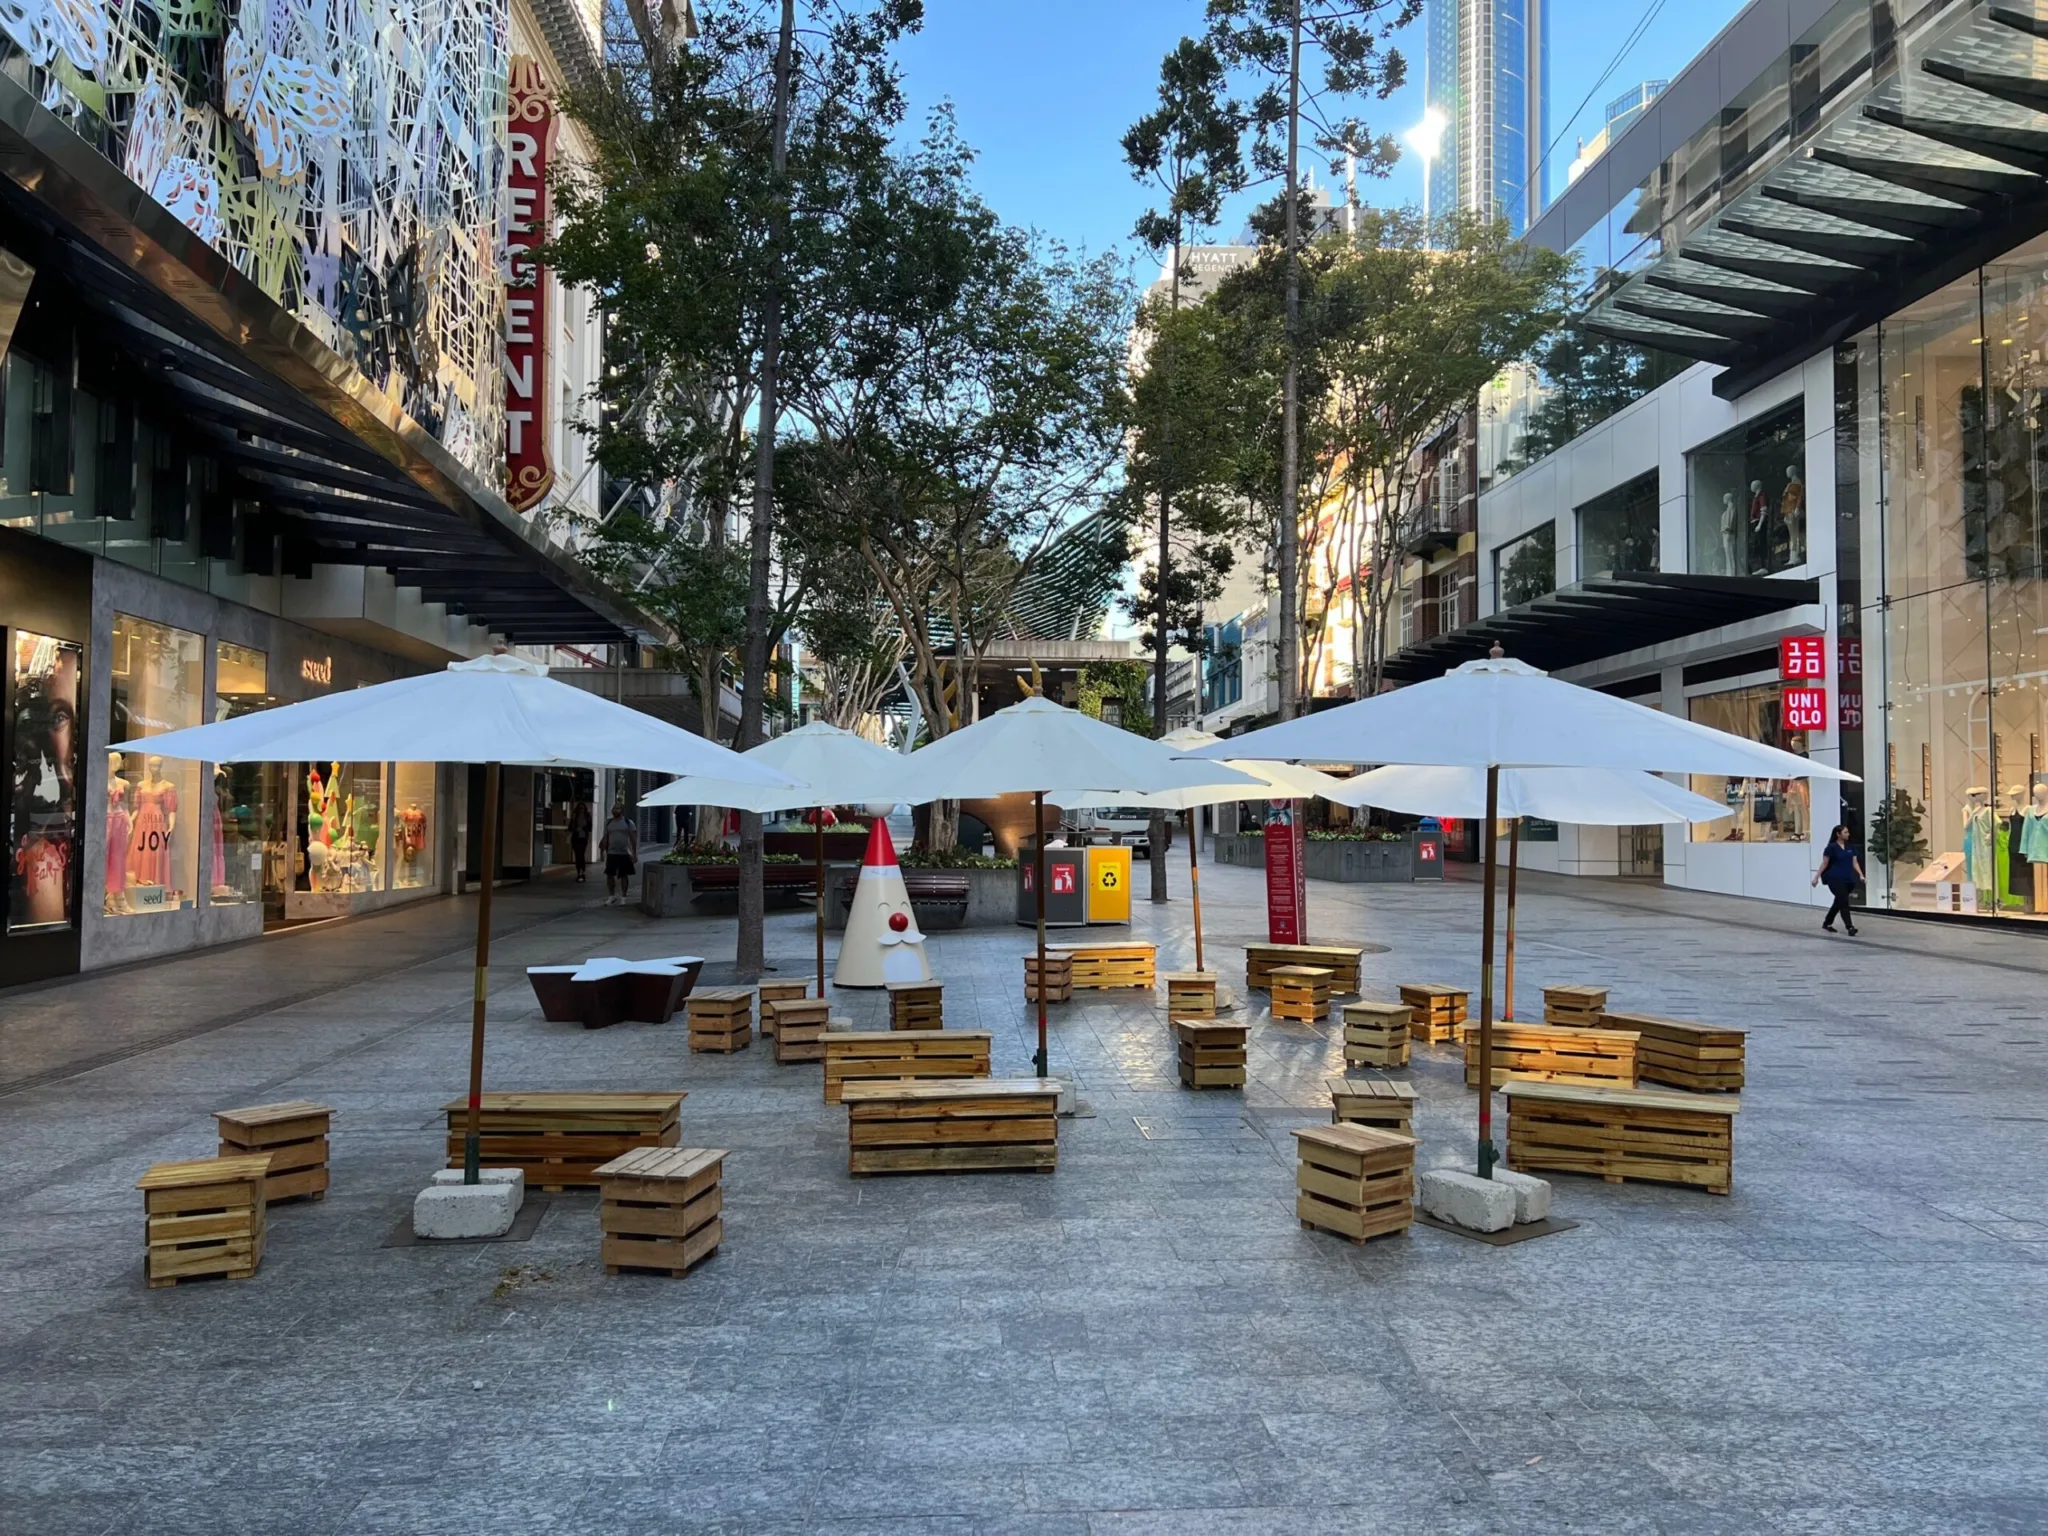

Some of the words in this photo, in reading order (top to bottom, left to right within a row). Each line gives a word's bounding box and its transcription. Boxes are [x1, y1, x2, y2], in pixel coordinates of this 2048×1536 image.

[1191, 252, 1238, 263] HYATT
[506, 131, 538, 455] REGENT
[302, 656, 331, 684] seed
[1788, 693, 1818, 708] UNI
[1789, 710, 1821, 727] QLO
[137, 831, 172, 851] JOY
[143, 889, 163, 905] seed
